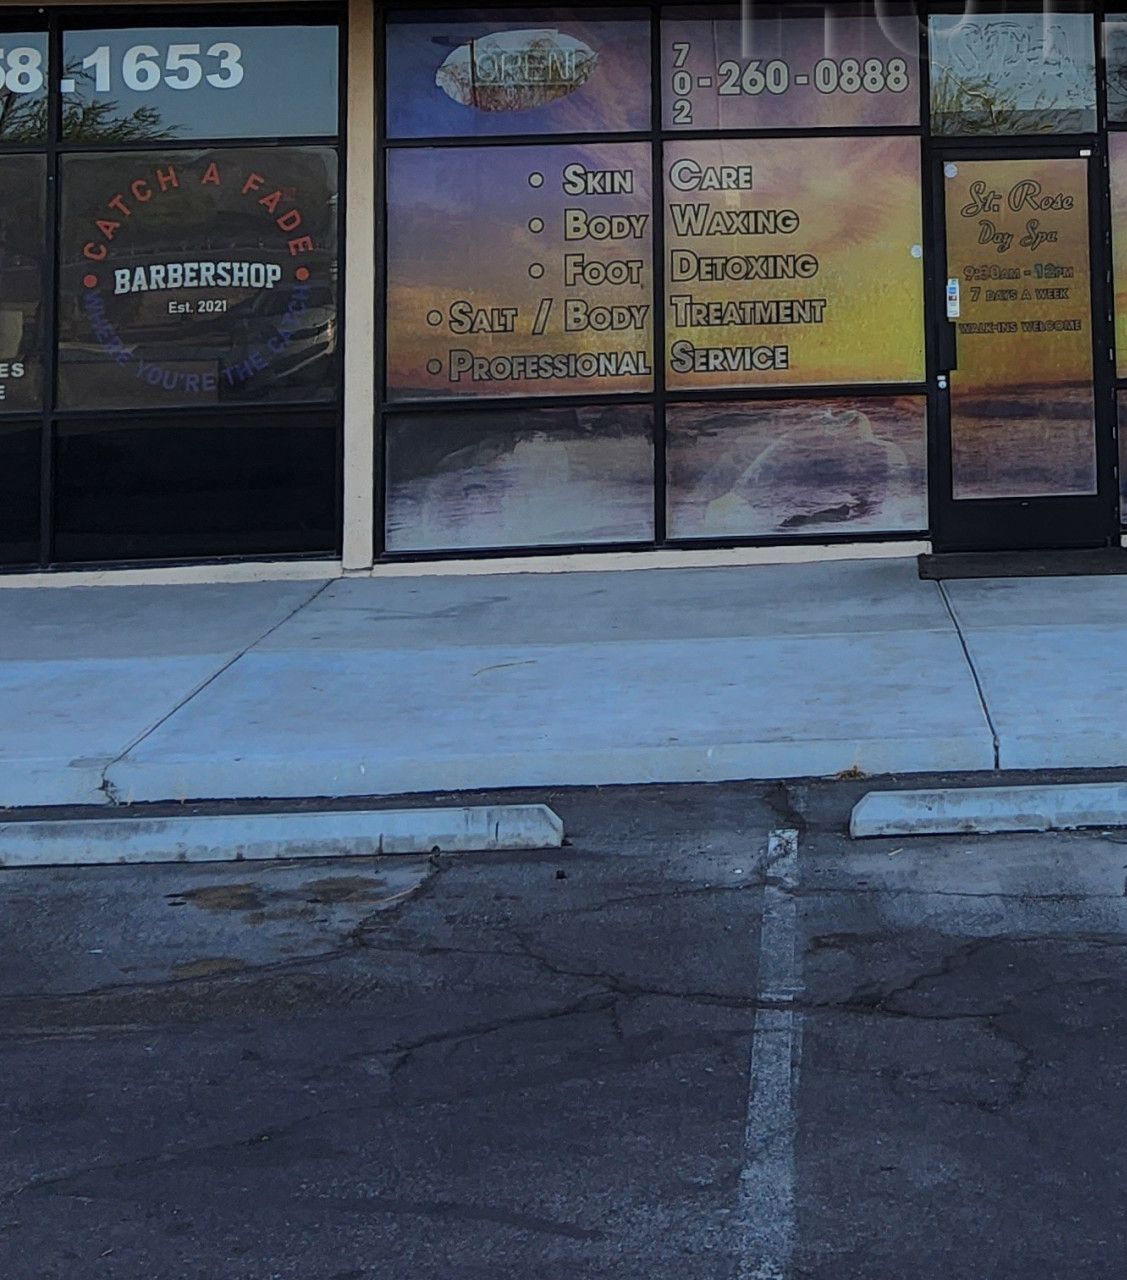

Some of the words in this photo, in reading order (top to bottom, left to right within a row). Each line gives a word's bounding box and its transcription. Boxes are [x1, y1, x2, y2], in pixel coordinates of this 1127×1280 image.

[562, 163, 633, 196] SKIN
[670, 158, 752, 191] CARE
[83, 166, 179, 261] CATCH
[202, 162, 221, 186] A
[241, 172, 313, 256] FADE
[961, 181, 1002, 217] St.
[1008, 179, 1074, 211] Rose
[564, 208, 649, 241] BODY
[670, 204, 800, 236] WAXING
[978, 220, 1014, 253] Day
[1020, 219, 1058, 251] Spa
[114, 262, 282, 295] BARBERSHOP
[564, 253, 643, 286] FOOT
[670, 249, 819, 282] DETOXING
[168, 301, 194, 314] Est.
[198, 299, 227, 313] 2021
[970, 286, 981, 302] 7
[1021, 288, 1032, 301] A
[1035, 287, 1070, 300] WEEK
[449, 300, 518, 334] SALT
[564, 299, 650, 331] BODY
[670, 295, 826, 327] TREATMENT
[449, 349, 651, 382] PROFESSIONAL
[670, 340, 788, 372] SERVICE
